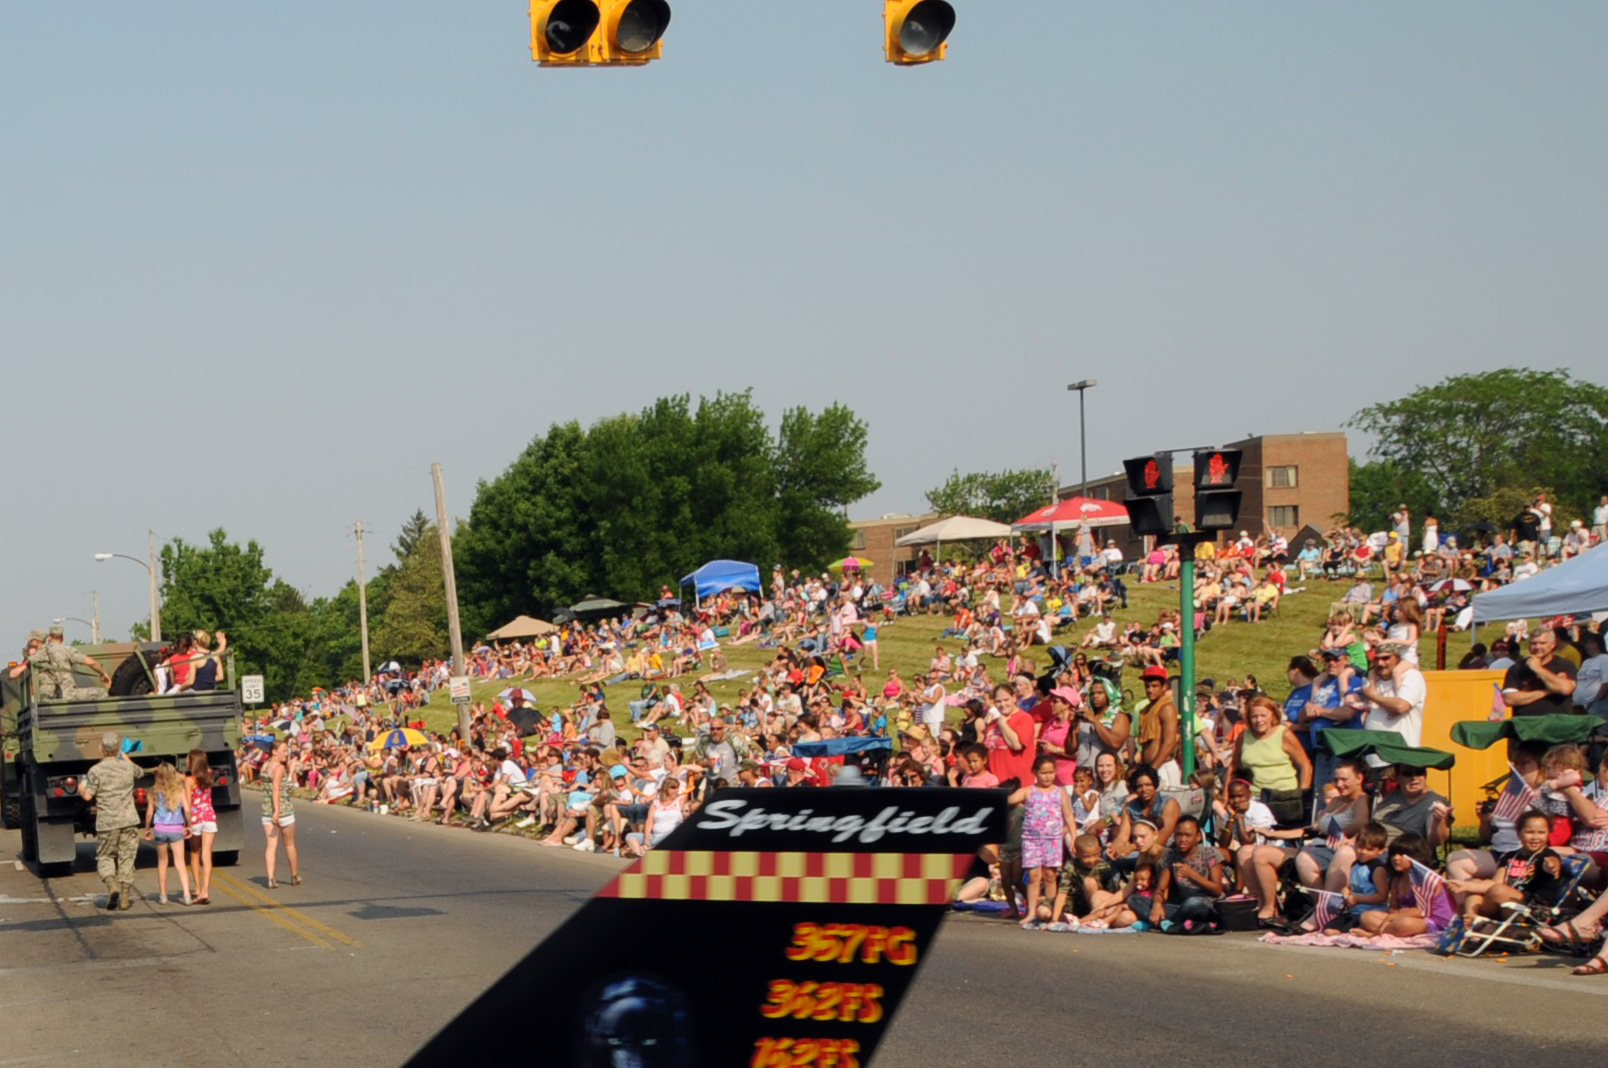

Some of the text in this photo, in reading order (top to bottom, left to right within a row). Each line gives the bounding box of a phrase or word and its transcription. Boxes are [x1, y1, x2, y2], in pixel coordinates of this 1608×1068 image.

[245, 689, 261, 699] 35
[697, 799, 994, 843] Springfield
[786, 921, 918, 966] 357FG
[760, 979, 885, 1023] 362FS
